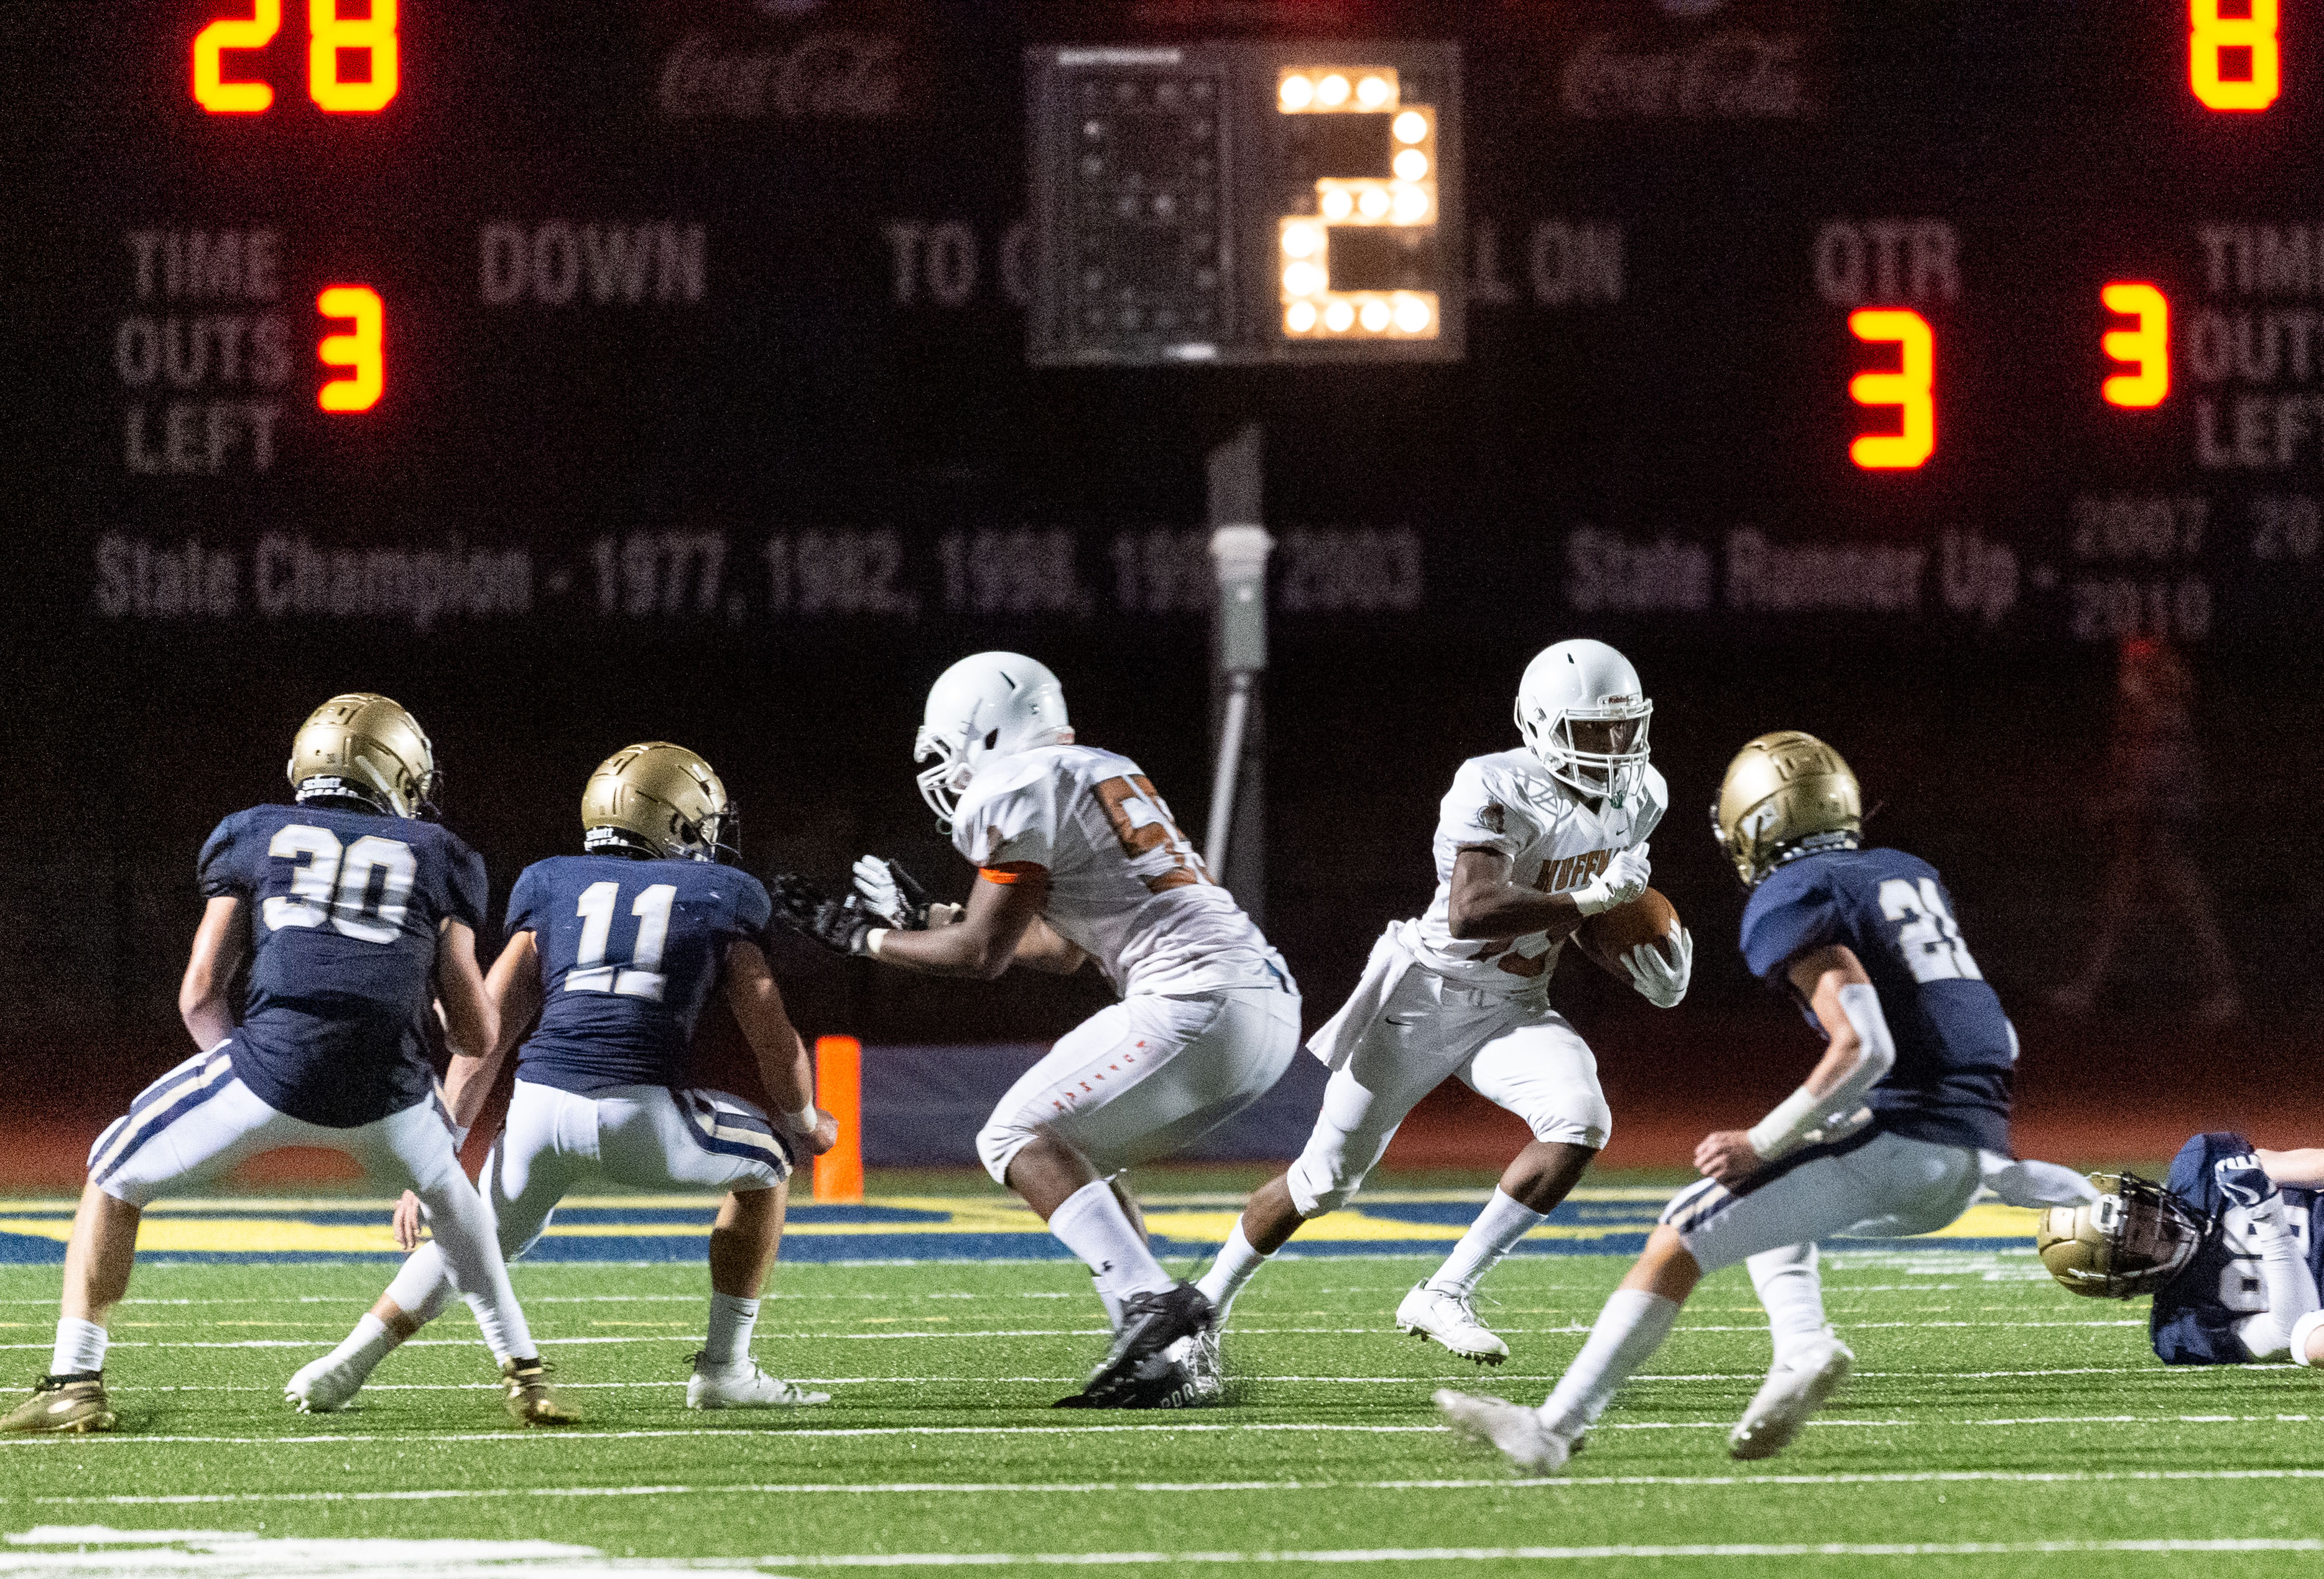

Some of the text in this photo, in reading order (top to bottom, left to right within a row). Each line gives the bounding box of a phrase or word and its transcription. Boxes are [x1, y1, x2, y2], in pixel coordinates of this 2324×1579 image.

[194, 0, 400, 114] 28
[2187, 0, 2281, 112] 8
[1278, 65, 1439, 340] 2
[127, 229, 281, 300] TIME
[479, 219, 708, 304] DOWN
[882, 220, 978, 306] TO
[1529, 219, 1624, 305] ON
[1813, 218, 1961, 304] QTR
[2195, 223, 2324, 296] TIM
[116, 312, 292, 387] OUTS
[316, 284, 386, 414] 3
[1849, 307, 1937, 471] 3
[2100, 280, 2172, 410] 3
[125, 399, 281, 475] LEFT
[95, 530, 237, 618] State
[254, 529, 532, 633] Champion
[1562, 524, 1711, 611] State
[1939, 526, 2021, 627] Up
[262, 823, 418, 945] 30
[565, 881, 677, 1001] 11
